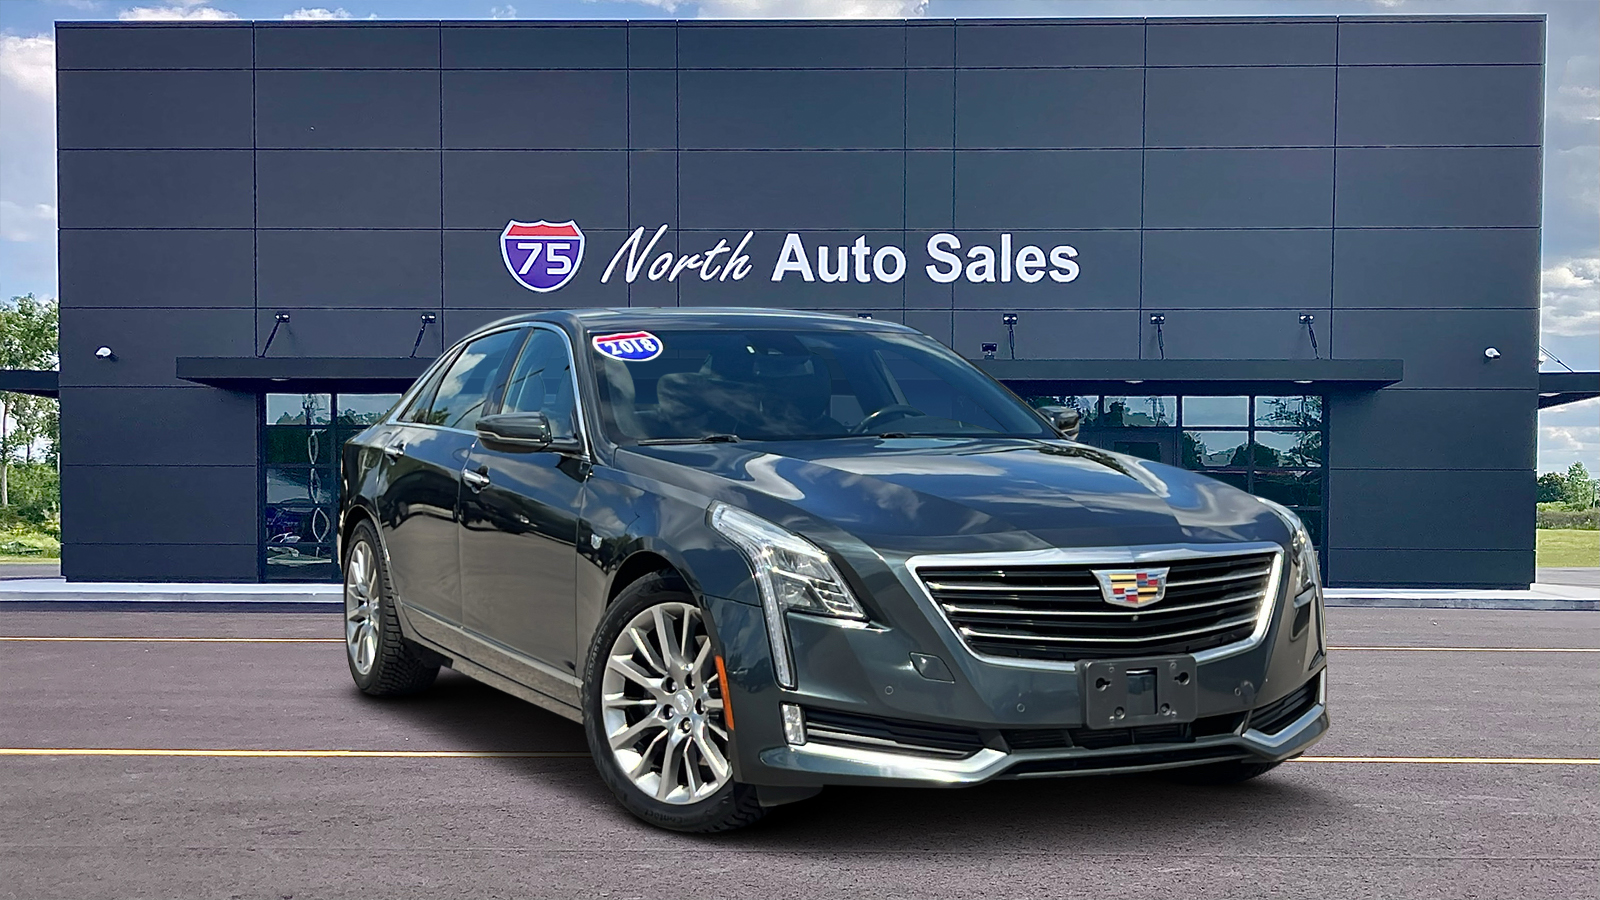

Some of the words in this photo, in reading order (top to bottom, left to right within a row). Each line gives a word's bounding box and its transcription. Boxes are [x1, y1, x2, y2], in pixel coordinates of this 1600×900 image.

[517, 242, 572, 275] 75
[601, 224, 754, 284] North
[771, 233, 907, 283] Auto
[926, 232, 1080, 284] Sales
[605, 338, 657, 355] 2018
